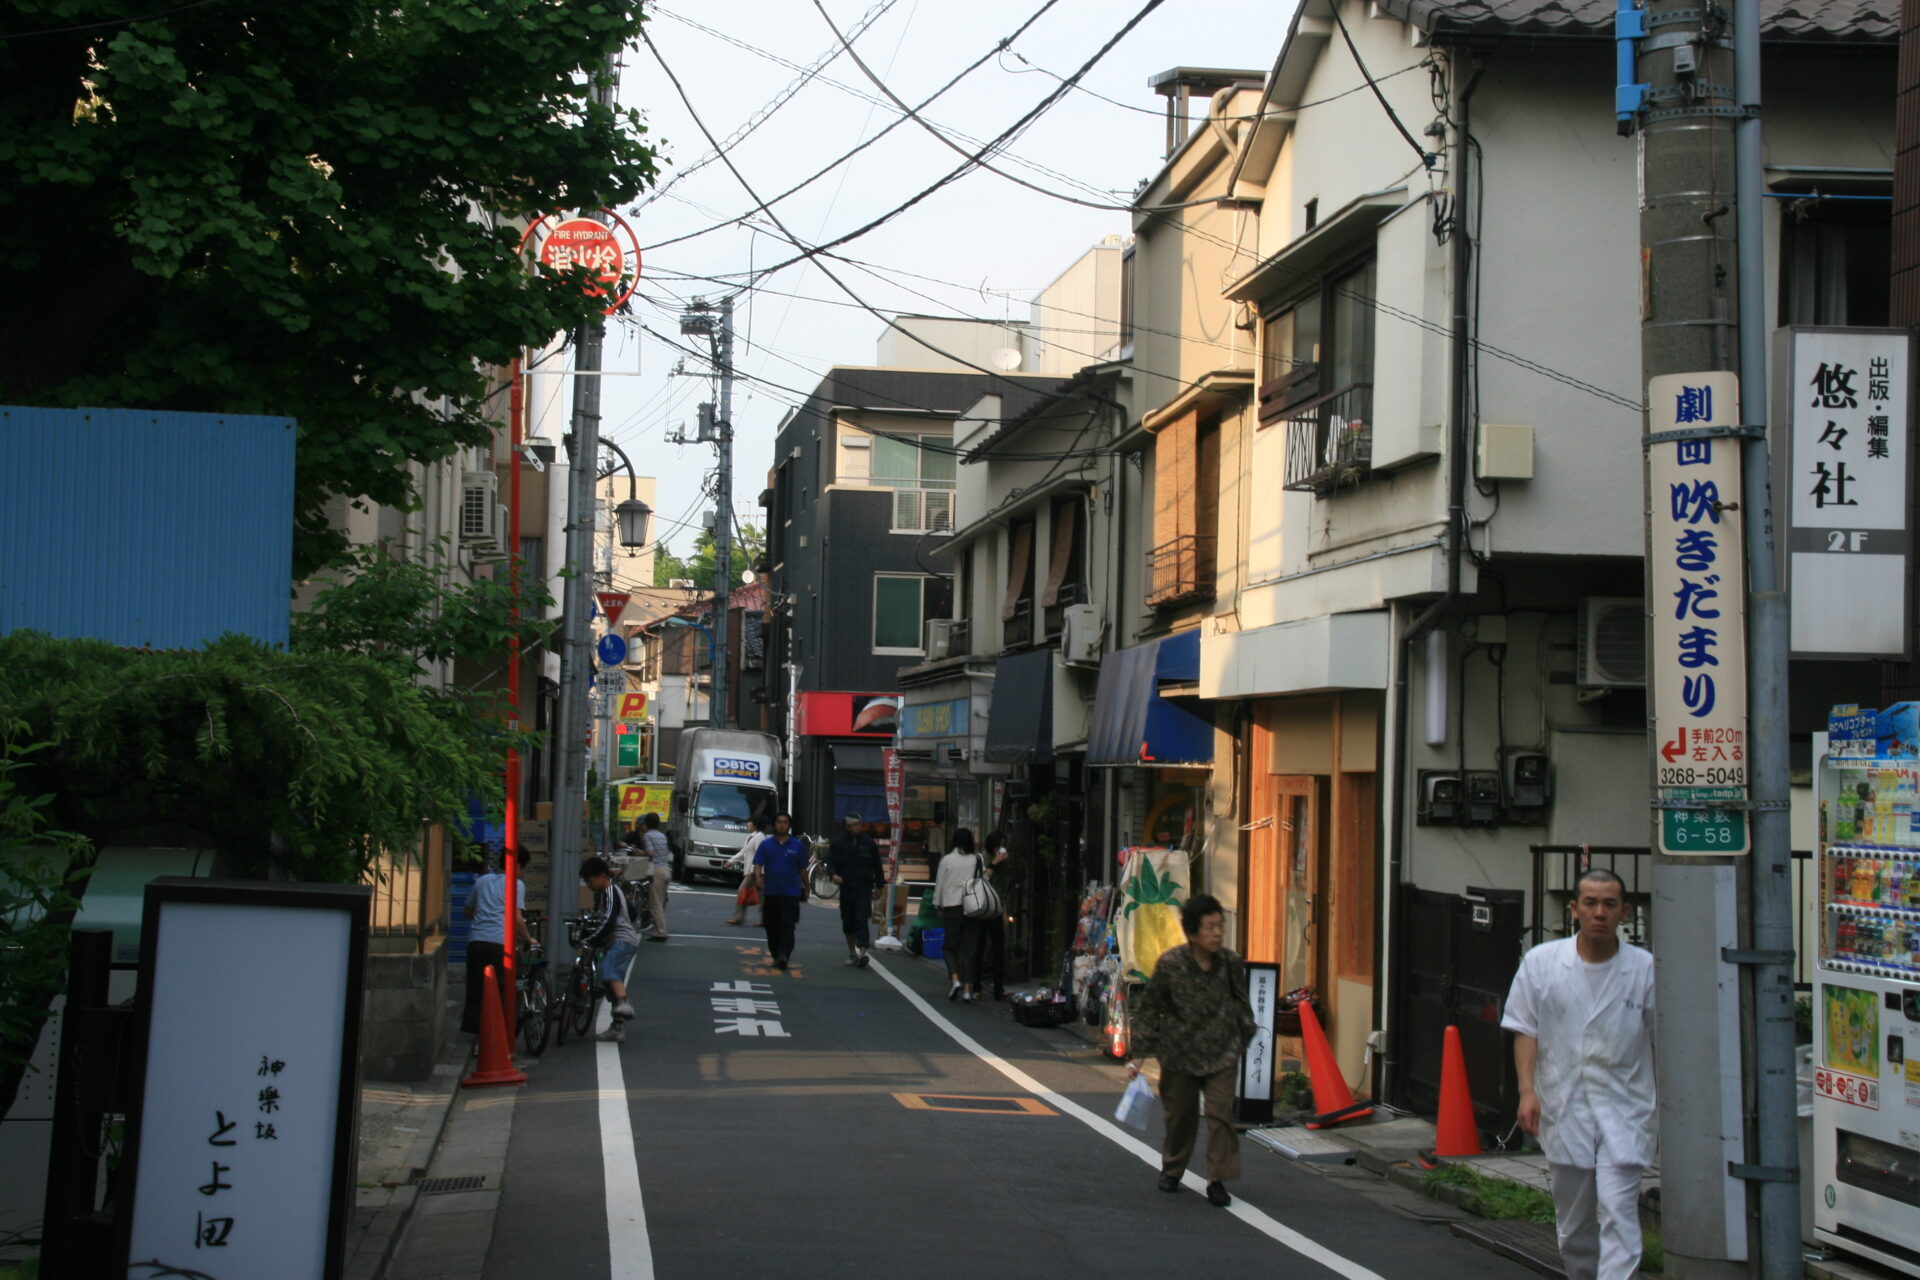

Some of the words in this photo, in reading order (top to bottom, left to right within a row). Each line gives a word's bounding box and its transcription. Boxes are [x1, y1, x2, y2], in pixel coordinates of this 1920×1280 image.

[554, 230, 571, 240] FIRE
[573, 230, 609, 240] HYDRANT
[548, 245, 617, 277] 消火栓
[1867, 356, 1890, 460] 出版・編集
[1810, 362, 1859, 509] 悠々社
[1827, 530, 1869, 552] 2F
[603, 599, 624, 607] 止まれ
[620, 693, 646, 717] P
[1692, 728, 1743, 744] 手前20m
[1692, 746, 1743, 762] 左入る
[1660, 767, 1744, 785] 3268-5049
[620, 787, 645, 811] P
[1676, 827, 1732, 844] 6-58
[709, 980, 792, 1037] 止まれ
[195, 1110, 237, 1249] とよ田
